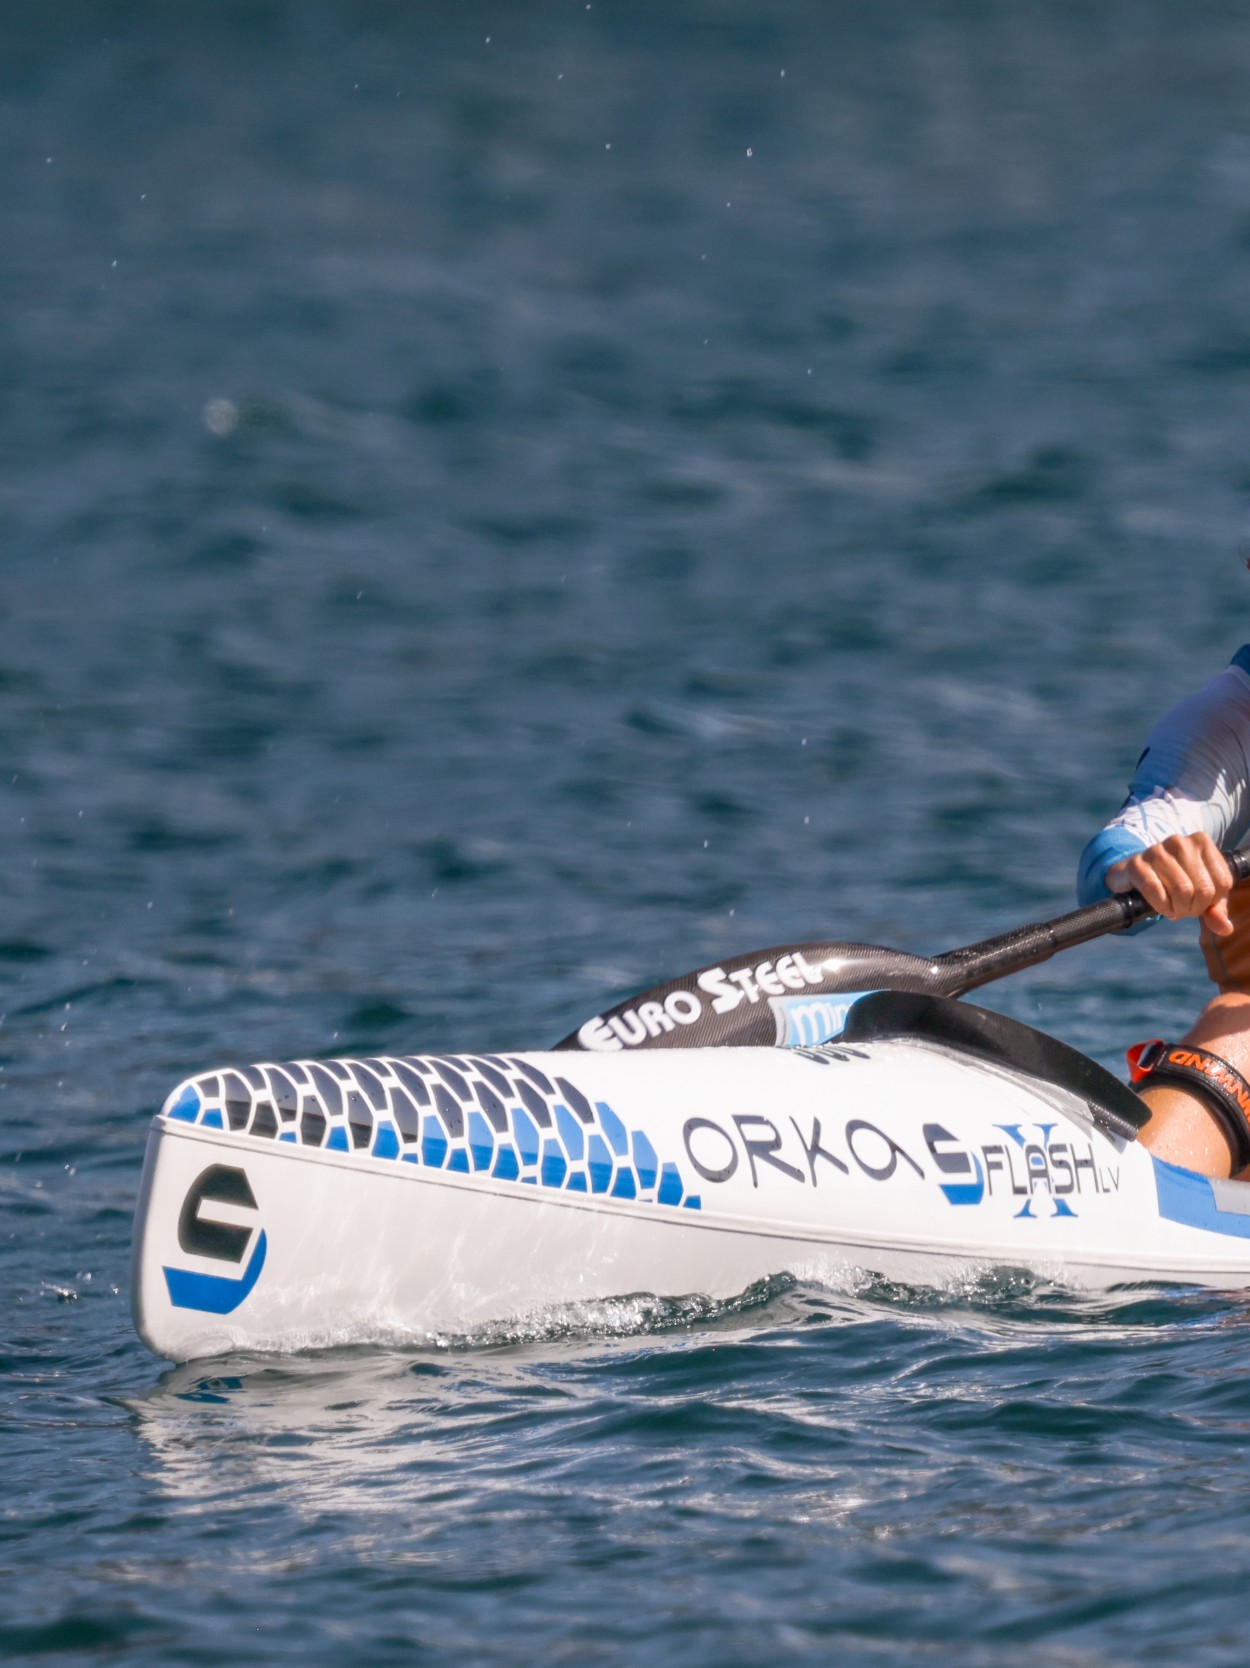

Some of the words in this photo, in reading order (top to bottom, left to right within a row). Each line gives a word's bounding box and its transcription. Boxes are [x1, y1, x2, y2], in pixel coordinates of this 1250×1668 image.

[577, 990, 702, 1051] EURO
[697, 951, 824, 1015] STEEL
[1099, 1165, 1121, 1193] LV
